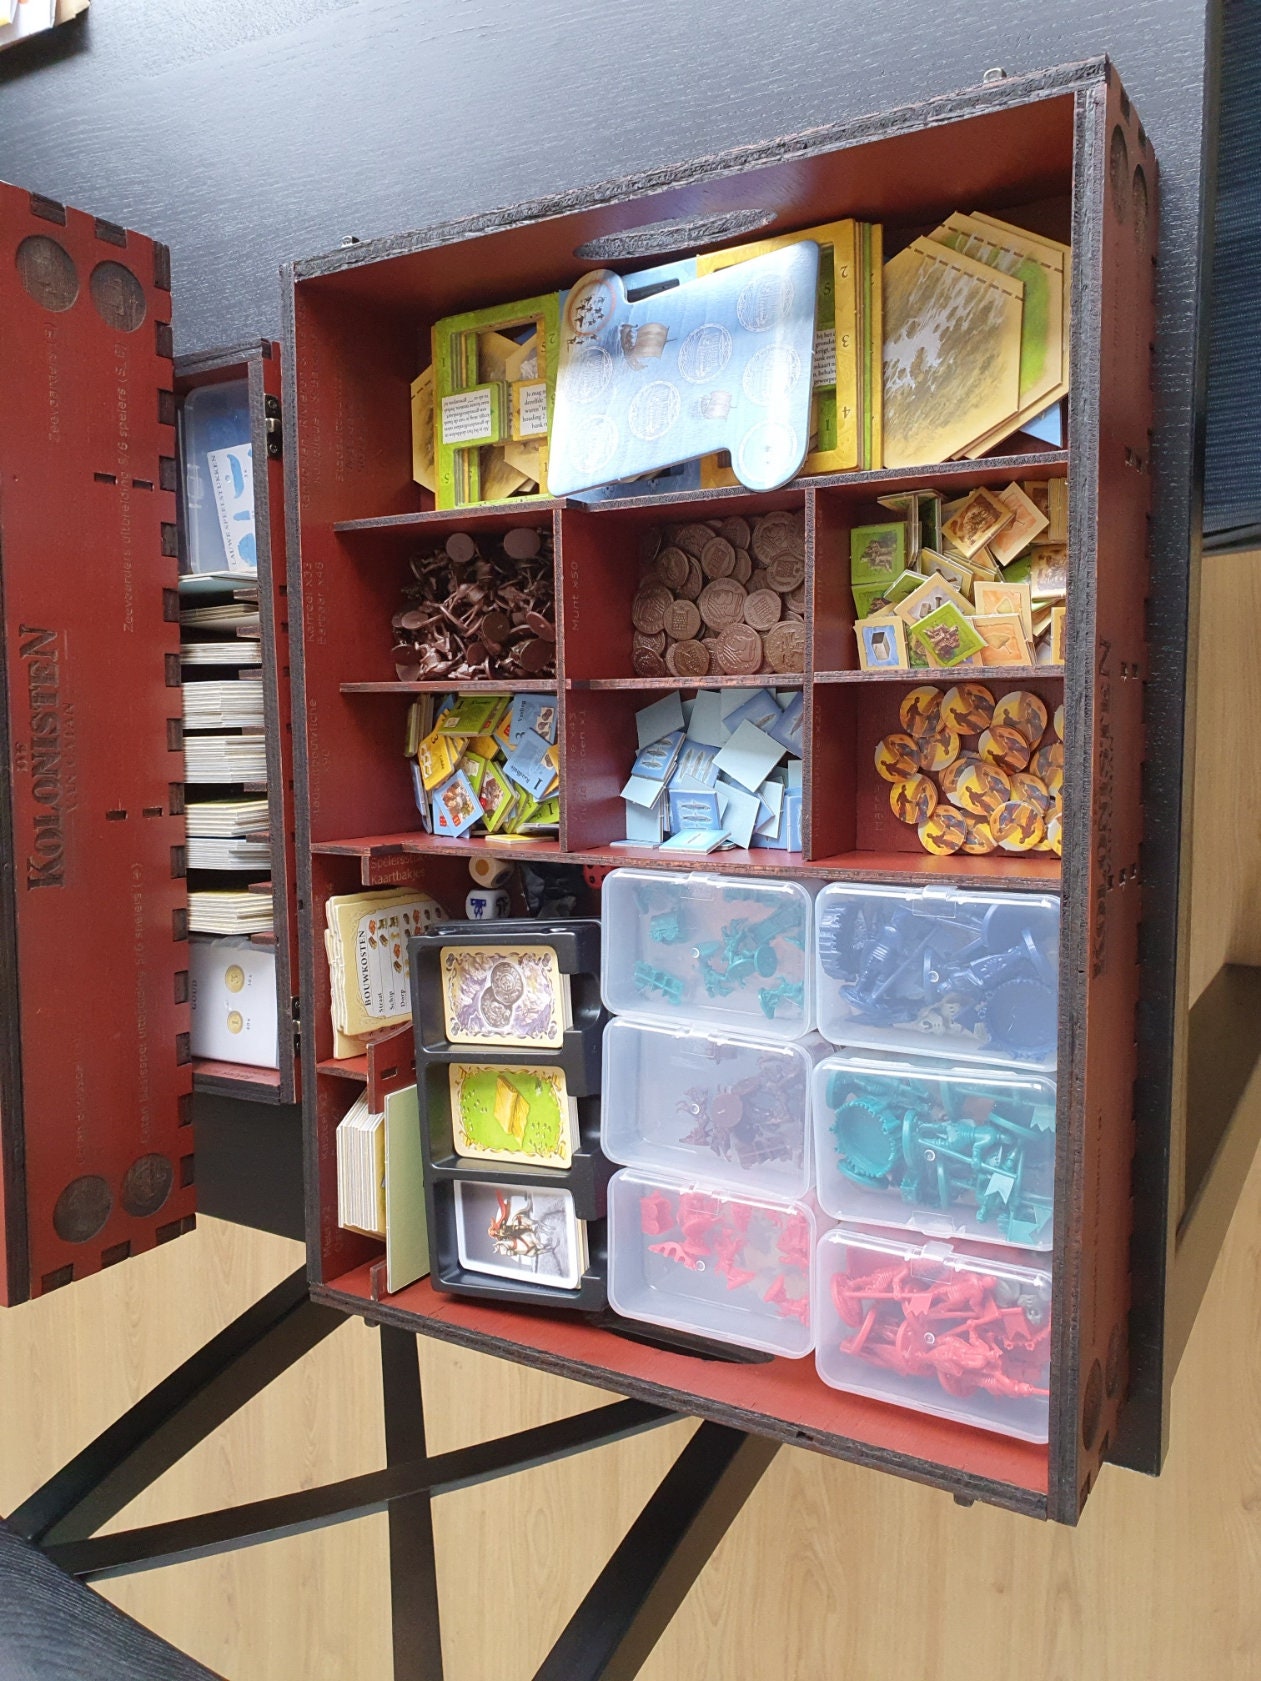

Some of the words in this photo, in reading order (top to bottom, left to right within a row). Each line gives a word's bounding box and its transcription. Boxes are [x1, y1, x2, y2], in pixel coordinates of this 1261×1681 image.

[840, 265, 848, 278] 2
[841, 334, 850, 348] 3
[116, 387, 129, 438] spelers
[841, 406, 850, 419] 4
[570, 560, 580, 589] x50
[571, 594, 580, 631] Munt
[18, 623, 66, 892] KOLONISTEN
[358, 930, 373, 1006] BOUWKOSTEN
[377, 993, 385, 1013] Straat
[388, 991, 397, 1010] Schip
[399, 989, 408, 1008] Dorp
